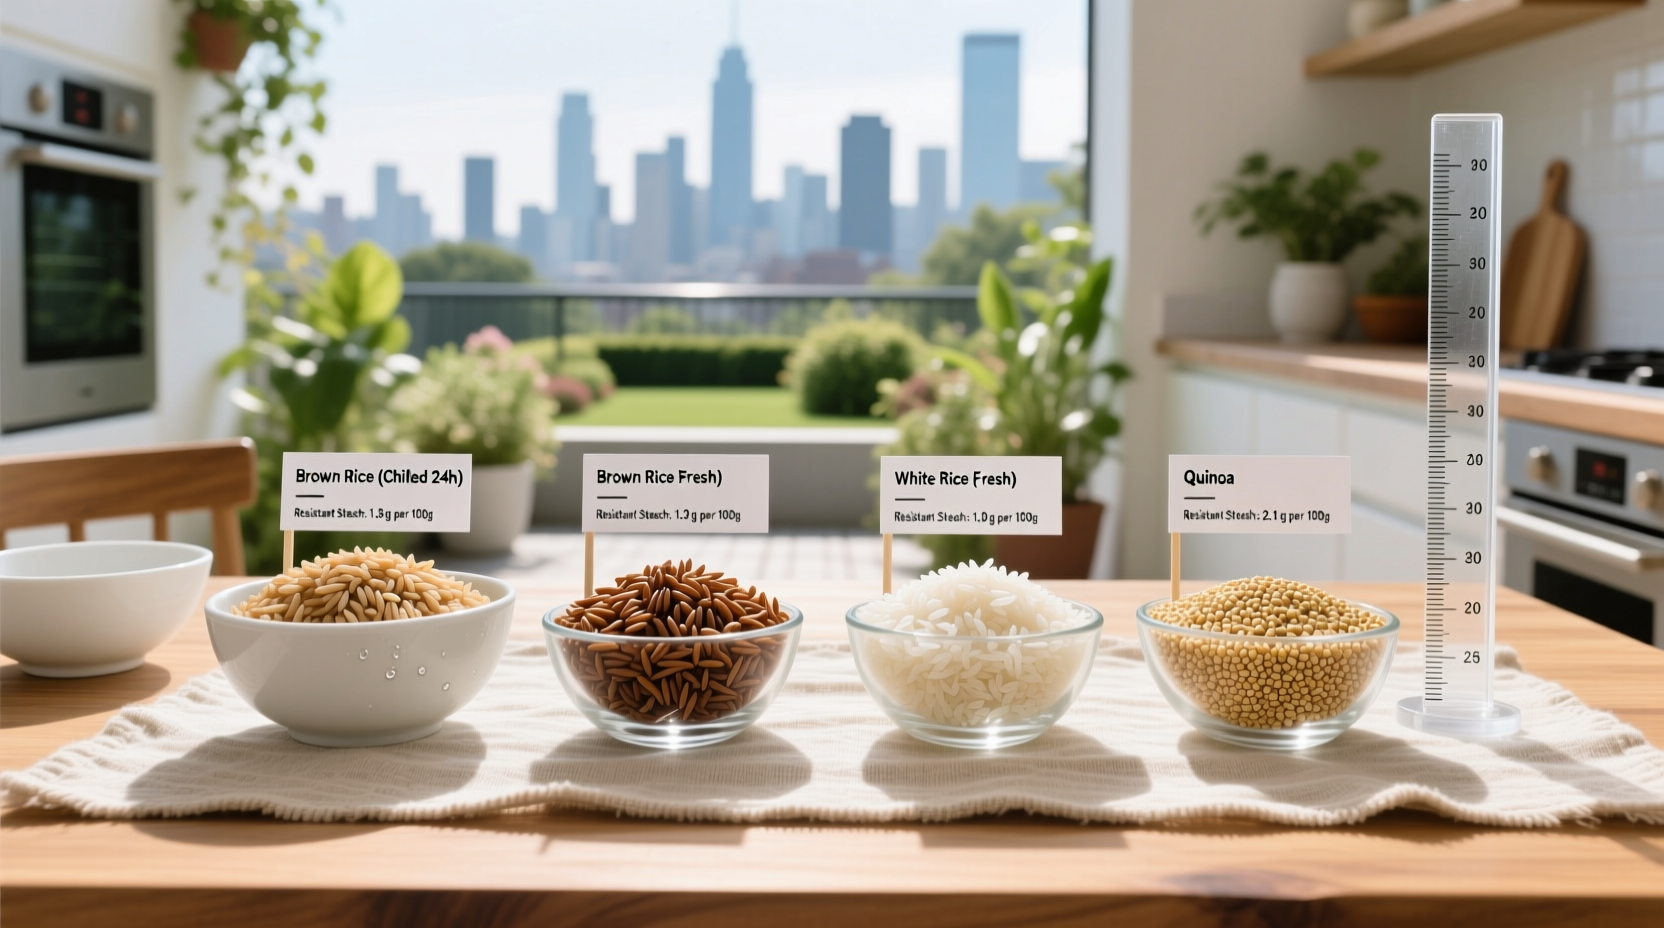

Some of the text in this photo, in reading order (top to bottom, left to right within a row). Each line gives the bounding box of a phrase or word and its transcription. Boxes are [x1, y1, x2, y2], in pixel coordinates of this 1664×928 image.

[1469, 206, 1488, 220] 20
[1468, 306, 1486, 320] 20
[295, 468, 341, 484] Brown
[344, 468, 375, 484] Rice
[431, 468, 464, 488] 24h)
[596, 469, 642, 485] Brown
[644, 469, 675, 485] Rice
[894, 470, 937, 486] White
[939, 470, 969, 486] Rice
[1183, 469, 1235, 488] Quinoa
[393, 510, 410, 523] per
[411, 508, 434, 523] 100g
[699, 511, 717, 524] per
[717, 509, 741, 524] 100g
[997, 514, 1013, 526] per
[1014, 511, 1039, 526] 100g
[1288, 512, 1305, 524] per
[1306, 509, 1331, 524] 100g
[1464, 601, 1481, 615] 20
